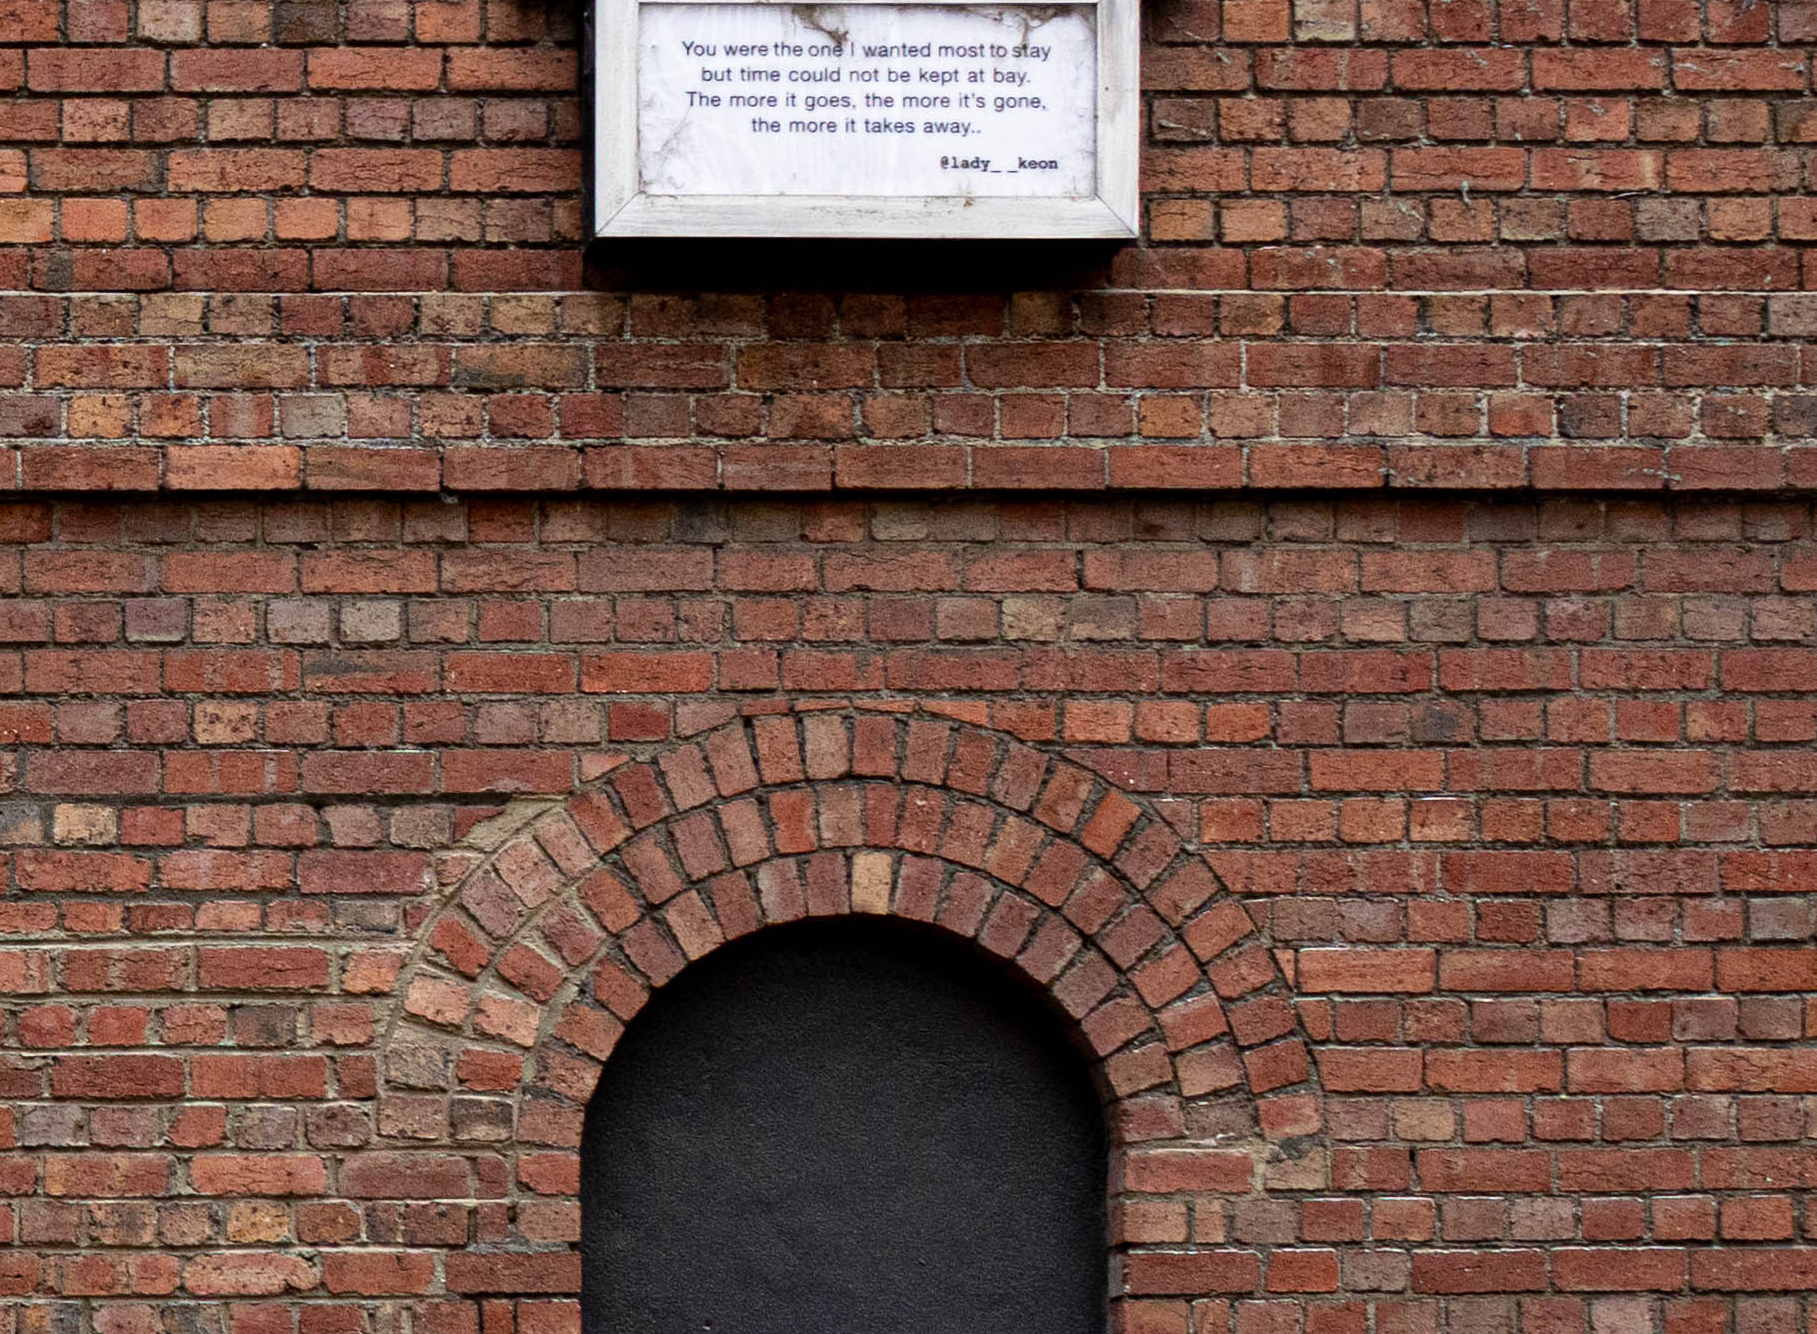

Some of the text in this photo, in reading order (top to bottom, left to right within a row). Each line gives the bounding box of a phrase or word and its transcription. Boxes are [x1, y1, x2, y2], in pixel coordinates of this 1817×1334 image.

[680, 40, 1053, 63] You were the one I wanted most to stay
[700, 66, 1031, 88] but time could not be kept at bay.
[684, 90, 1047, 114] The more it goes, the more it's gone,
[750, 116, 982, 138] the more it takes away..
